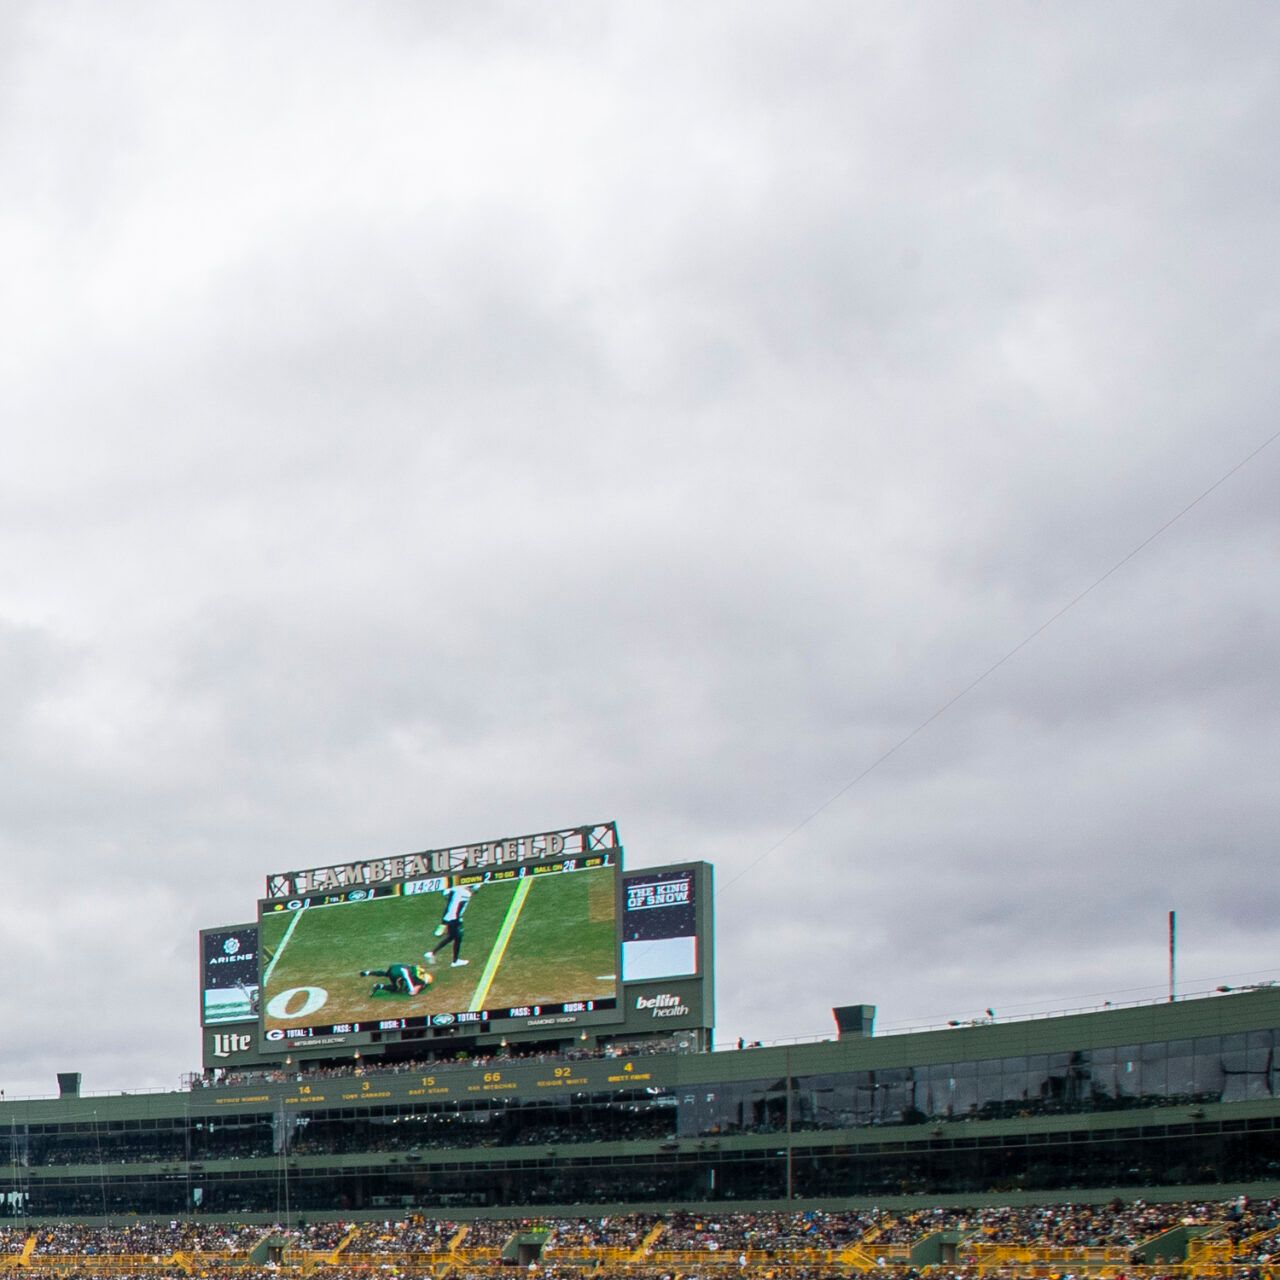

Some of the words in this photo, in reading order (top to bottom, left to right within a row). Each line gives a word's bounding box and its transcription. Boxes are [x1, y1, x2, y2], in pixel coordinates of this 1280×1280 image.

[305, 850, 450, 891] LAMBEAU
[468, 834, 564, 867] FIELD
[460, 875, 482, 884] DOWN
[484, 872, 491, 883] 2
[534, 866, 551, 874] BALL
[411, 878, 441, 892] 14:20
[628, 886, 653, 897] THE
[656, 882, 688, 896] KING
[628, 896, 645, 907] OF
[647, 891, 688, 904] SNOW
[209, 954, 254, 964] ARIENS
[563, 1002, 585, 1012] RUSH:
[587, 1001, 594, 1011] 0
[635, 994, 681, 1010] bellin
[457, 1011, 481, 1022] TOTAL:
[482, 1010, 489, 1020] 0
[510, 1007, 531, 1017] PASS:
[533, 1006, 541, 1016] 0
[652, 1005, 689, 1018] health
[379, 1020, 400, 1029] RUSH:
[527, 1017, 554, 1026] DIAMOND
[555, 1016, 576, 1024] VISION
[287, 1028, 307, 1038] TOTAL:
[309, 1027, 314, 1037] 1
[333, 1024, 352, 1033] PASS:
[354, 1023, 360, 1033] 0
[213, 1033, 251, 1058] Lite
[322, 1037, 346, 1045] ELECTRIC
[554, 1067, 571, 1077] 92
[623, 1062, 633, 1073] 4
[422, 1077, 435, 1086] 15
[483, 1072, 501, 1082] 66
[299, 1086, 311, 1094] 14
[362, 1081, 370, 1091] 3
